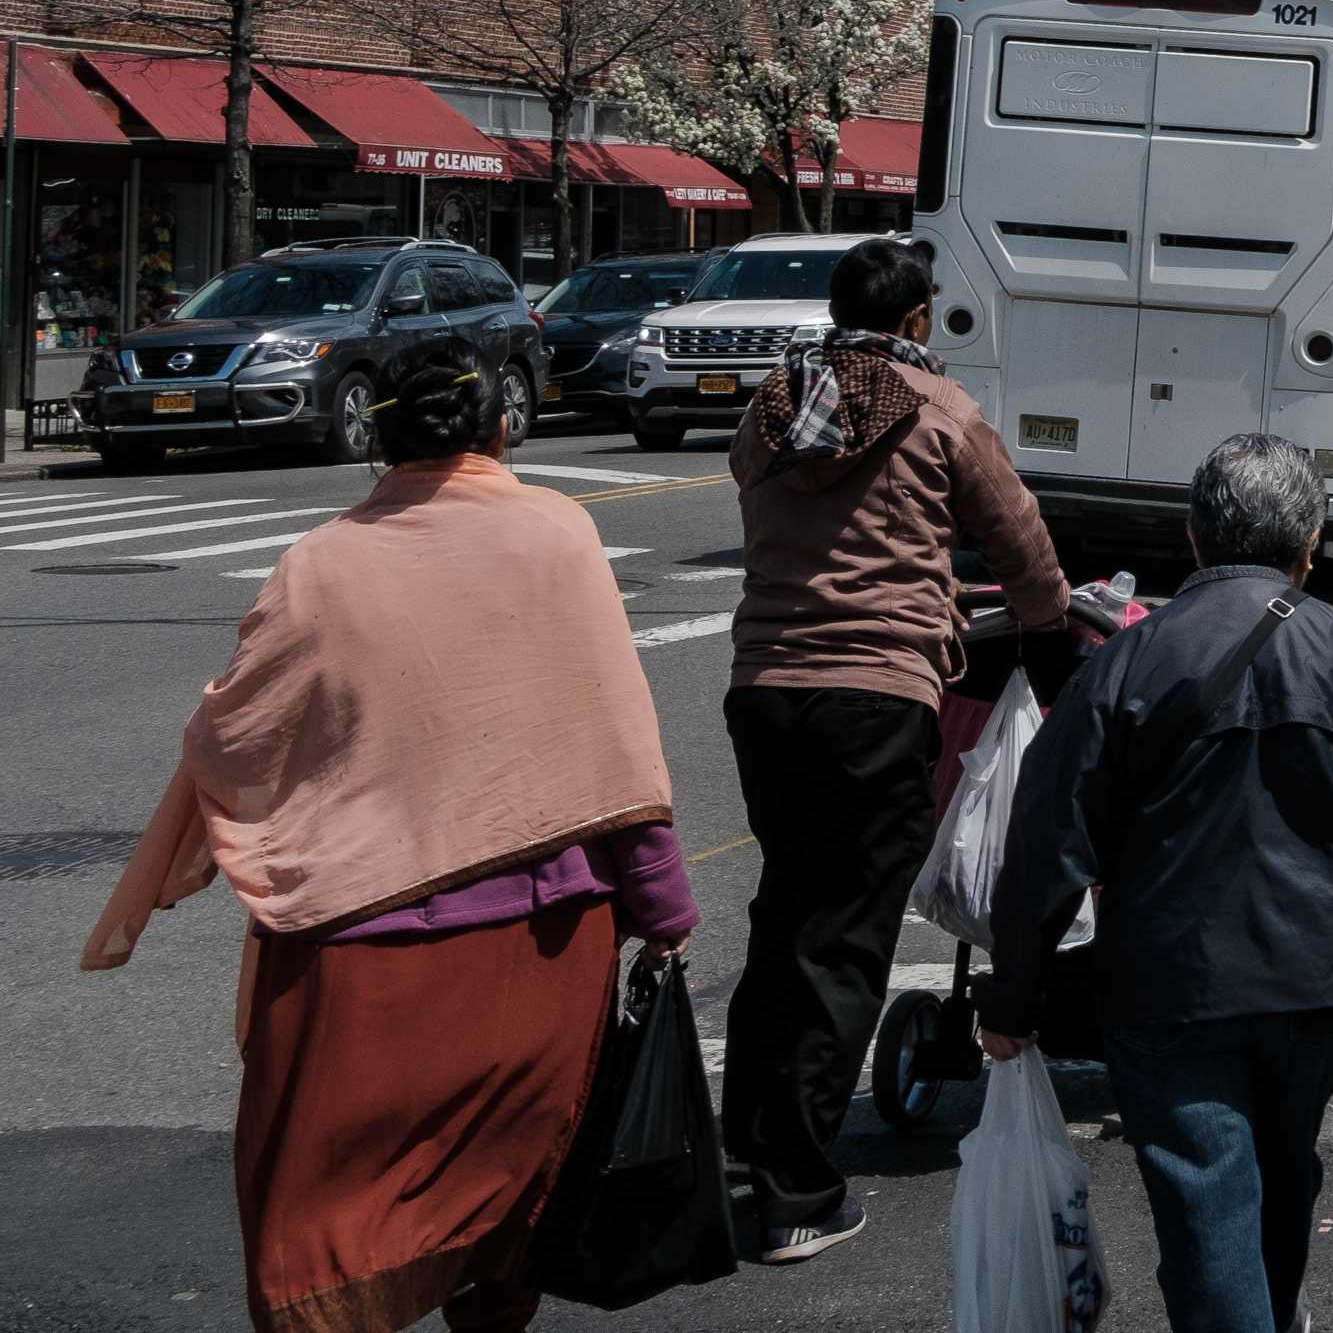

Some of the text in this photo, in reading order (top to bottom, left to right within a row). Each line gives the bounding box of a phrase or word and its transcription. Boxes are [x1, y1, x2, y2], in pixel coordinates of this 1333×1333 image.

[1271, 3, 1318, 27] 1021
[1015, 48, 1077, 65] MOTOR
[1023, 97, 1129, 116] INDUSTRIES
[396, 150, 430, 169] UNIT
[433, 152, 504, 174] CLEANERS
[256, 207, 320, 221] DRY CLEANERS
